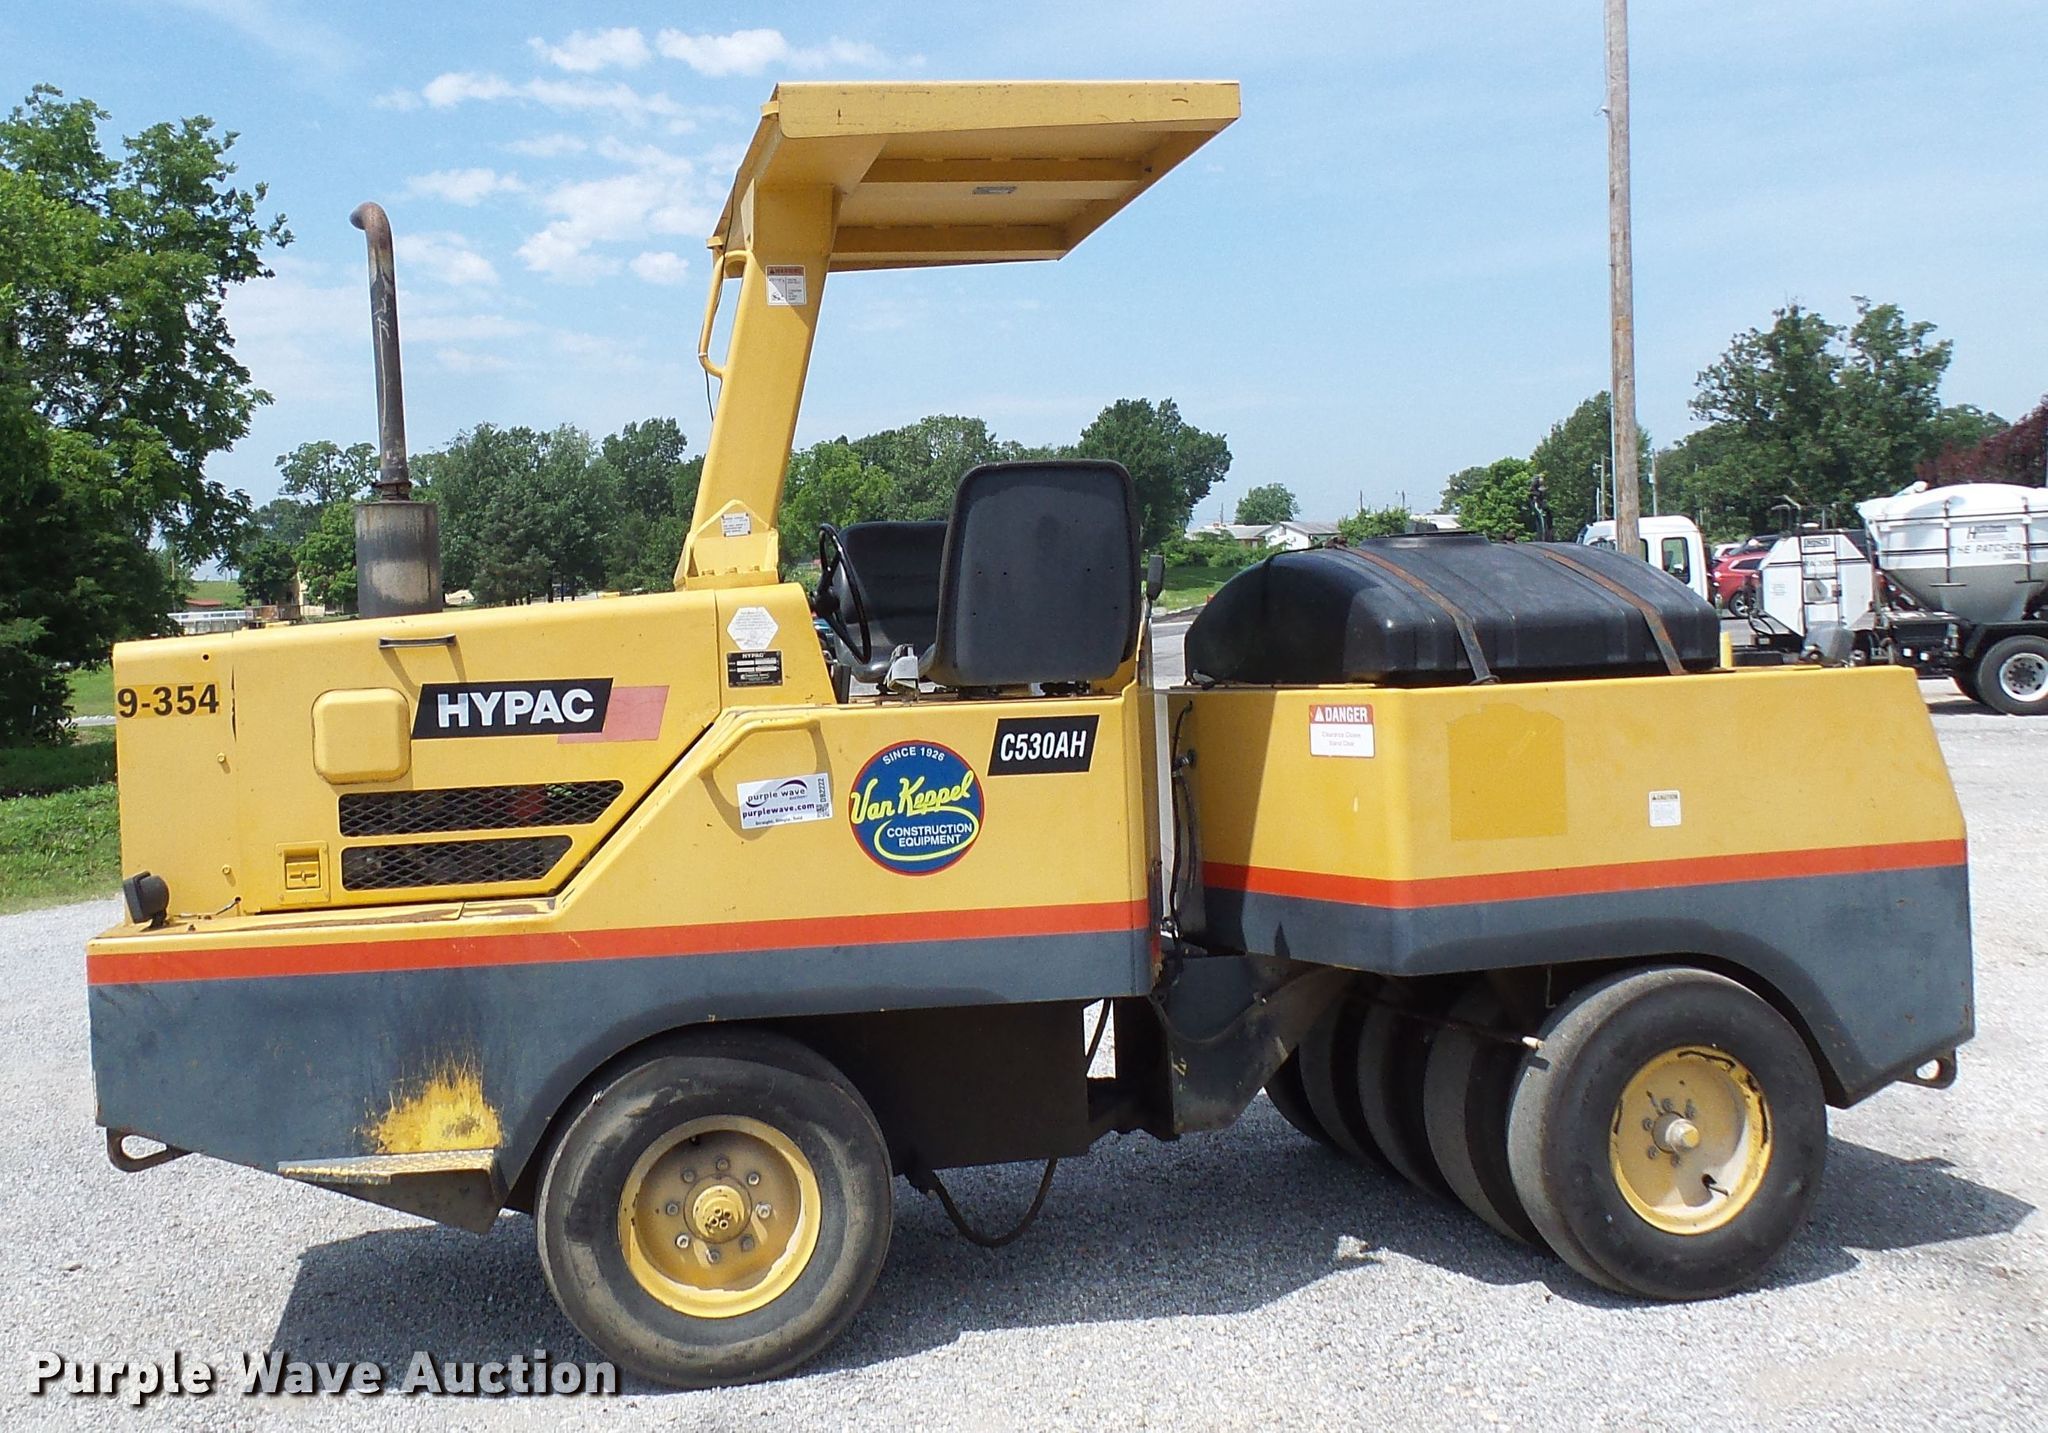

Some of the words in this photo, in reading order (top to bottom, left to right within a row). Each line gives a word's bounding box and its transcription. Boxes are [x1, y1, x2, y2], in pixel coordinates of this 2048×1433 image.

[117, 683, 220, 718] 9-354
[437, 688, 594, 728] HYPAC
[1325, 706, 1368, 722] DANGER
[1000, 730, 1087, 762] C530AH
[882, 746, 917, 765] SINCE
[920, 746, 946, 762] 1926
[747, 791, 778, 803] purple
[781, 788, 806, 797] wave
[850, 778, 895, 824] Van
[897, 769, 975, 817] Keppel
[742, 802, 815, 819] purplewave.com
[886, 822, 973, 838] CONSTRUCTION
[898, 833, 962, 847] EQUIPMENT
